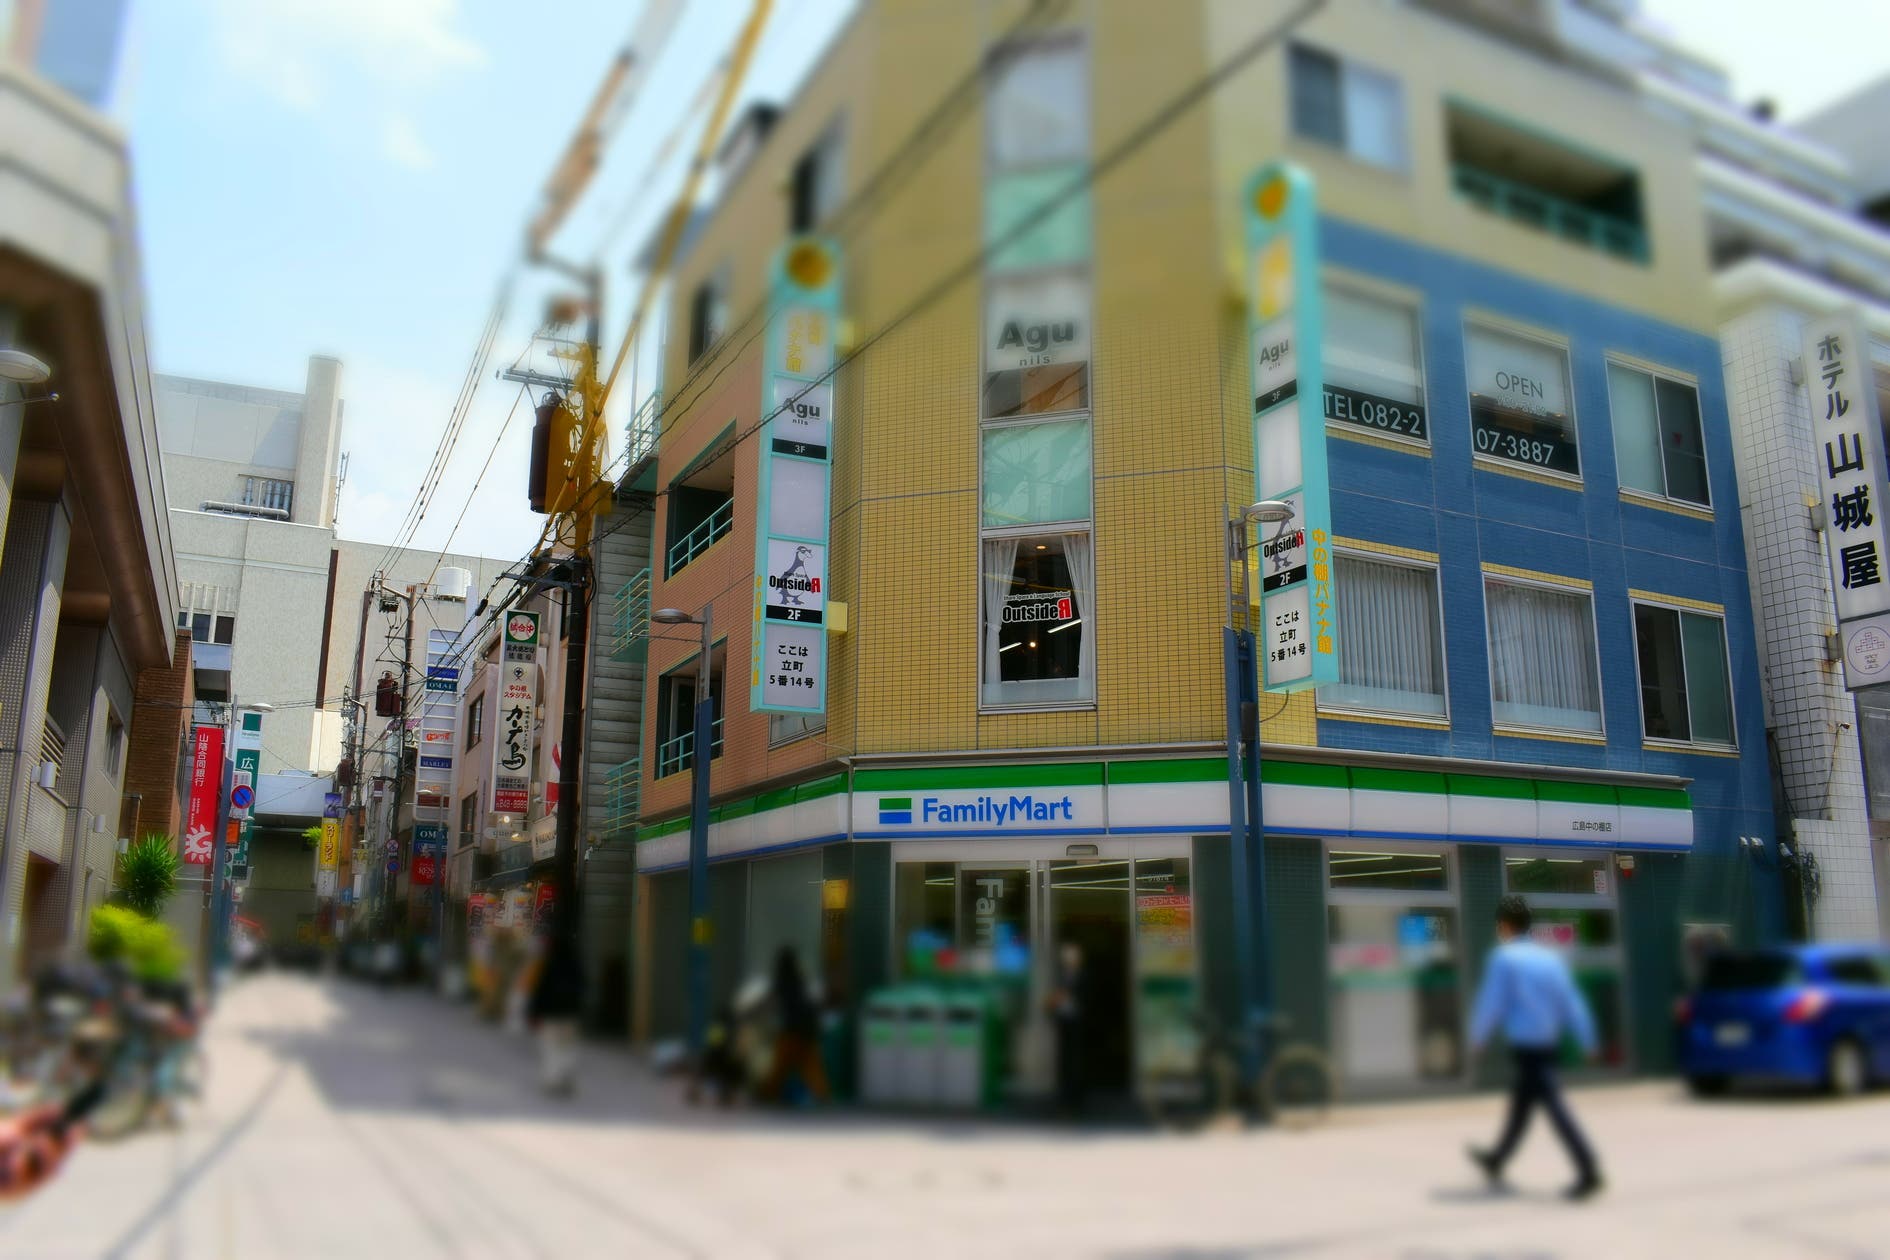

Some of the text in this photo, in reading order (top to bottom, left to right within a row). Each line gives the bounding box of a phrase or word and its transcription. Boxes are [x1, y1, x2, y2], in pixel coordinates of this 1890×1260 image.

[997, 319, 1075, 352] Agu
[1259, 339, 1289, 365] Agu
[1019, 355, 1051, 367] nils
[1495, 371, 1543, 399] OPEN
[1272, 390, 1281, 402] 3F
[784, 398, 820, 418] Agu
[794, 445, 806, 454] 3F
[1476, 428, 1554, 464] 07-3887
[1279, 572, 1291, 586] 2F
[787, 610, 801, 621] 2F
[1275, 611, 1300, 627] ここは
[1279, 629, 1297, 644] 立町
[778, 645, 808, 657] ここは
[1271, 643, 1307, 662] 5番14号
[781, 660, 804, 672] 立町
[769, 675, 815, 689] 5番14号
[195, 733, 209, 787] 山陰合同銀行
[923, 796, 1073, 825] FamilyMart
